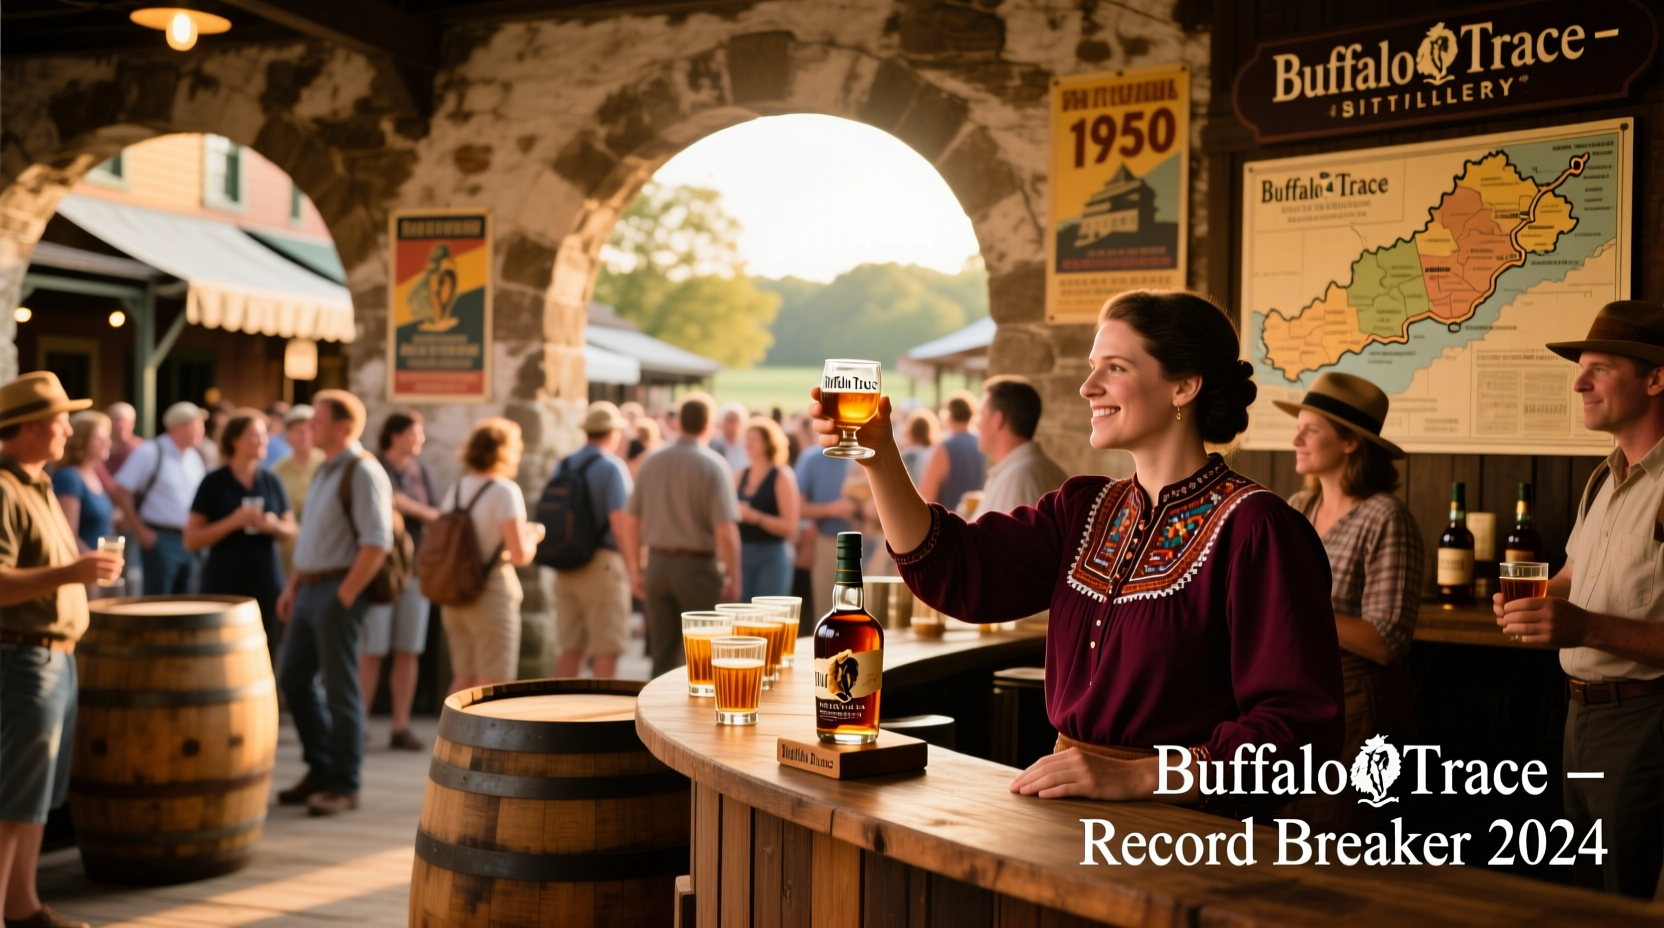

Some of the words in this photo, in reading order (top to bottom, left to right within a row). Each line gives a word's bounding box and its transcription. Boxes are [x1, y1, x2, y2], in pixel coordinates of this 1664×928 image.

[1272, 40, 1415, 102] Buffalo
[1460, 22, 1586, 74] Trace
[1069, 107, 1176, 168] 1950
[1261, 177, 1323, 204] Buffalo
[1335, 172, 1389, 197] Trace
